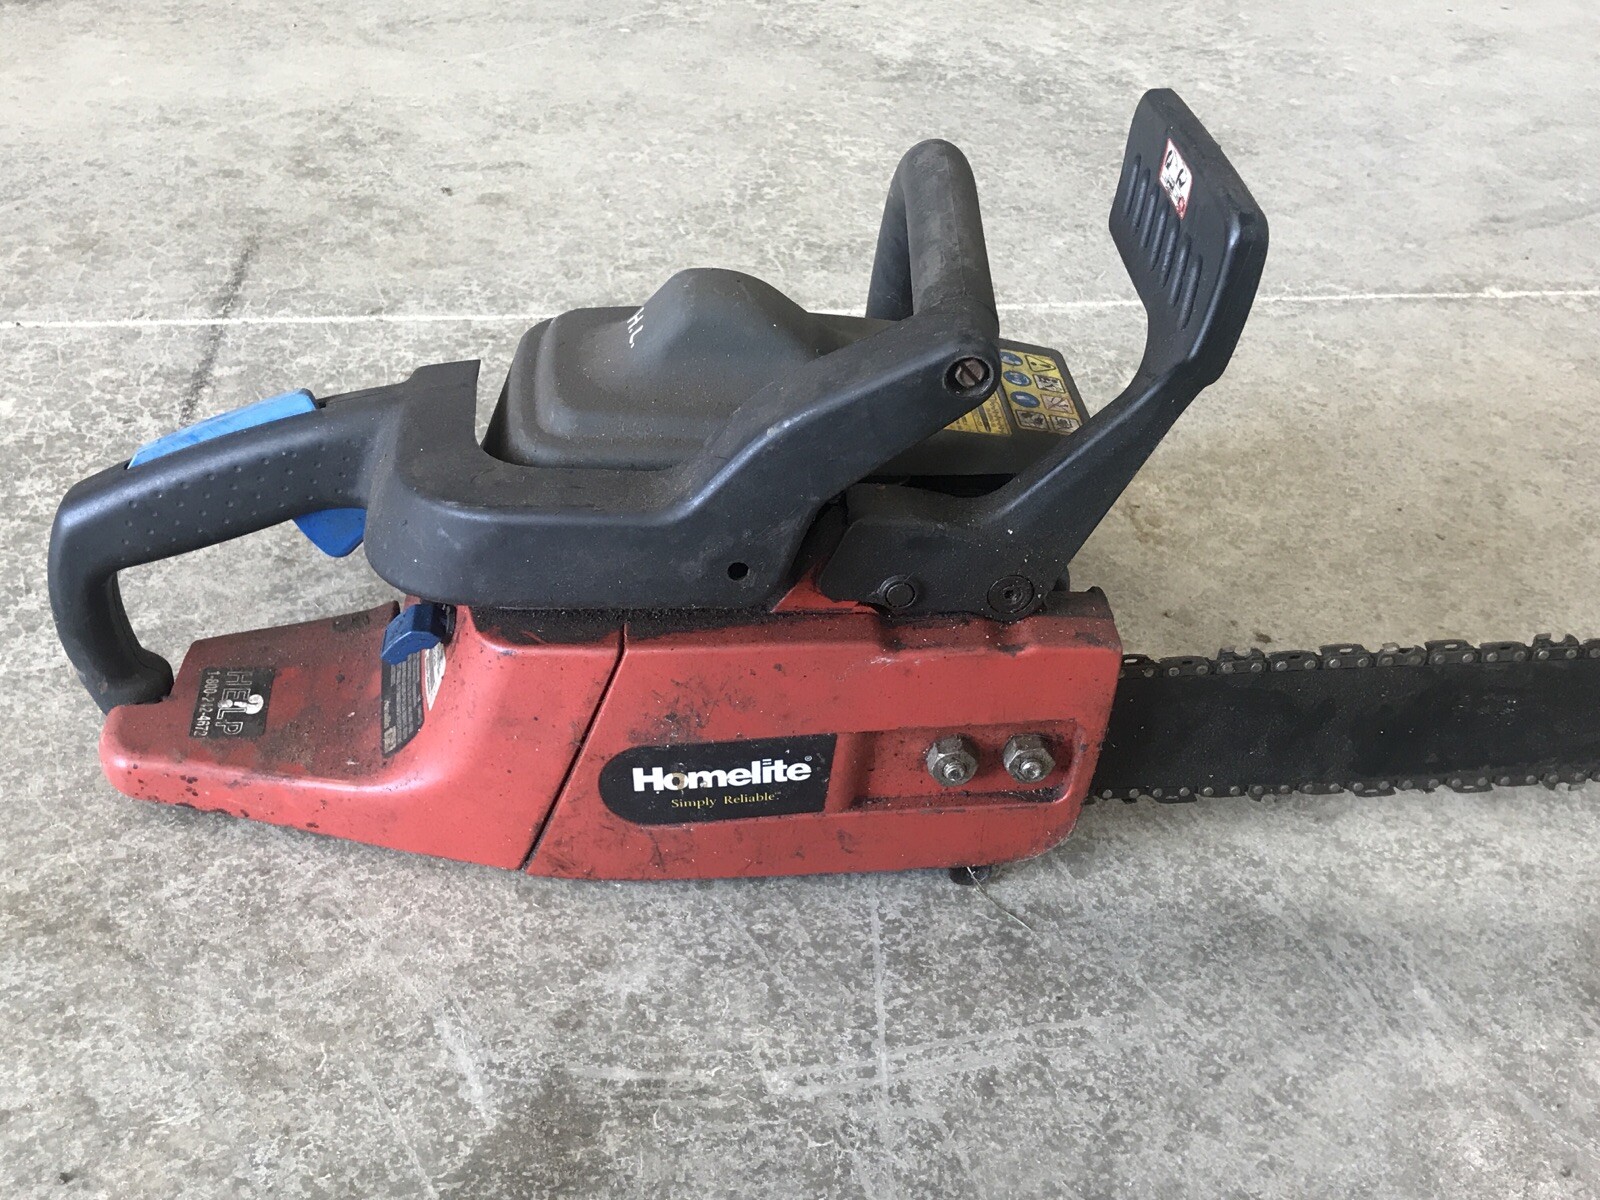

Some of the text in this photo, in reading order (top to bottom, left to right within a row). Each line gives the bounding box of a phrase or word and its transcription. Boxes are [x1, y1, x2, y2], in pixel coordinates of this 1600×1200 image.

[632, 758, 812, 792] Homelite
[671, 792, 776, 809] Simply Reliable
